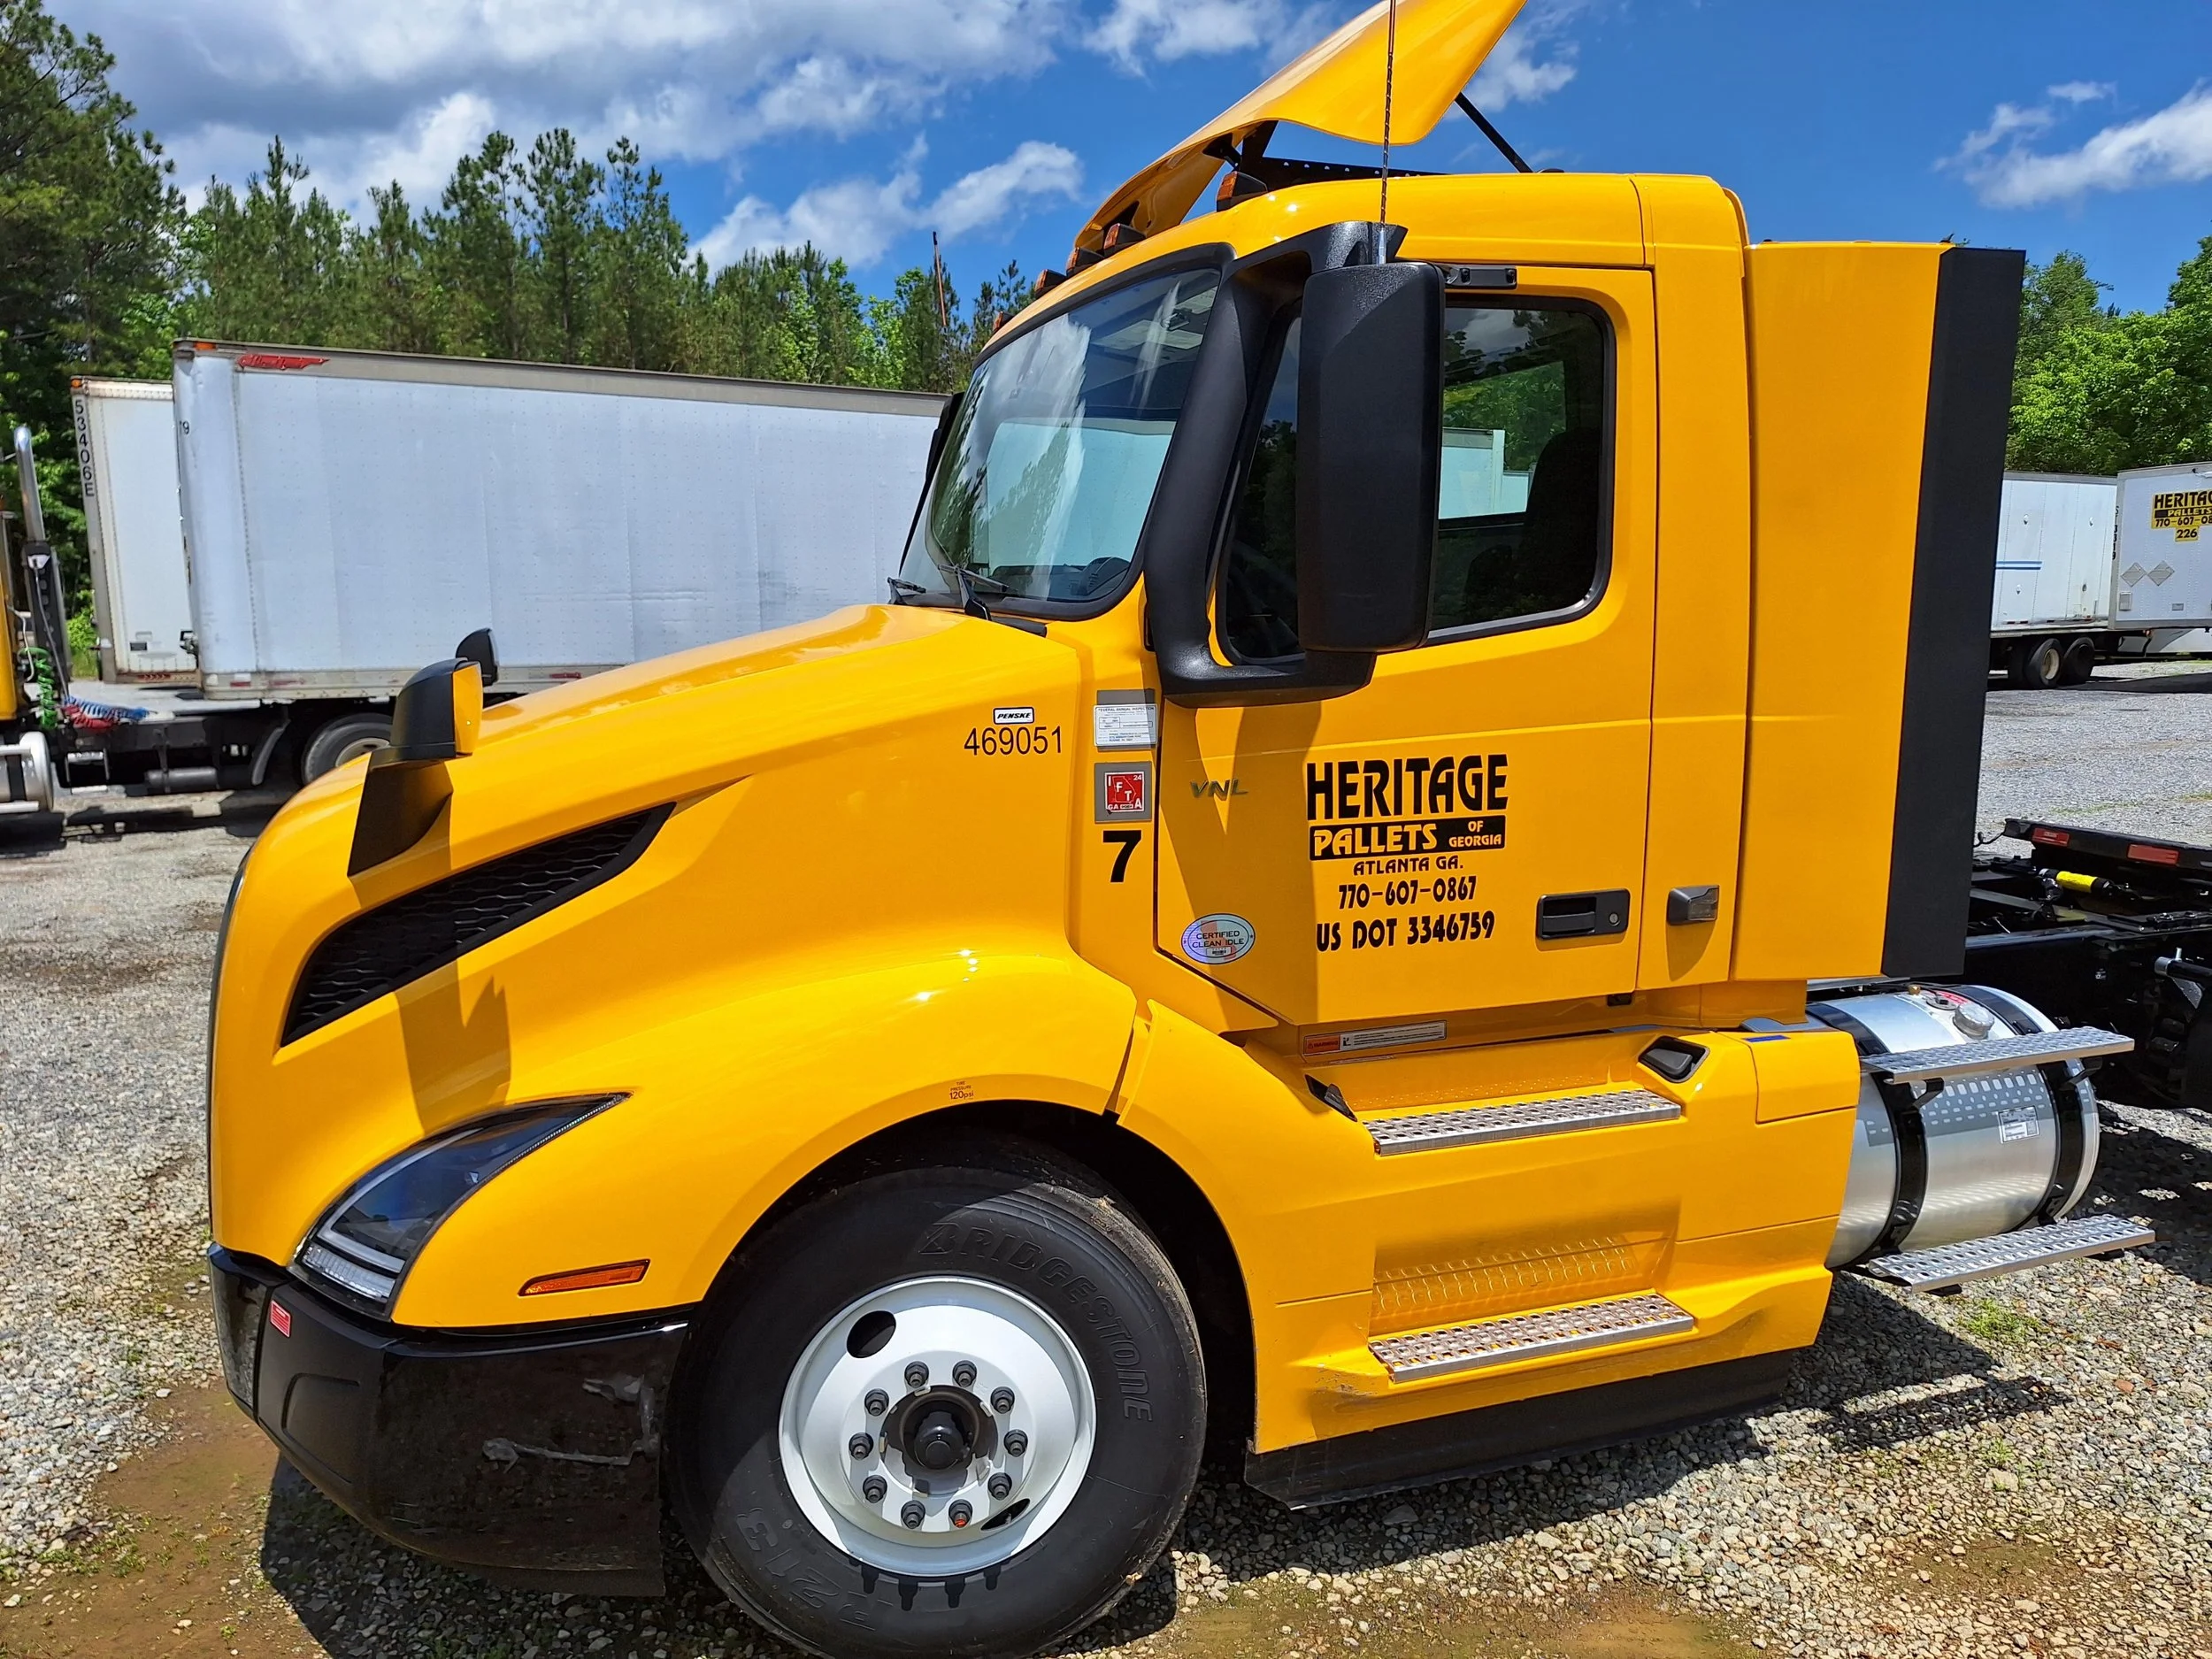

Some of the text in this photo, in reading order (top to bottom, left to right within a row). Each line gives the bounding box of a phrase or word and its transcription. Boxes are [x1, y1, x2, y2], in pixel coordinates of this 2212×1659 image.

[74, 399, 95, 496] 53406E
[2168, 507, 2212, 517] PALLETS
[2176, 528, 2198, 539] 226
[964, 726, 1062, 756] 469051
[1190, 779, 1248, 799] VNL
[1306, 754, 1509, 820] HERITAGE
[1467, 820, 1484, 833] OF
[1313, 823, 1438, 856] PALLETS
[1448, 833, 1502, 849] GEORGIA
[1102, 830, 1142, 883] 7
[1353, 855, 1464, 876] ATLANTA GA.
[1338, 875, 1477, 910] 770-607-0867
[1195, 930, 1240, 940] CERTIFIED
[1316, 910, 1495, 952] US DOT 3346759
[949, 1090, 974, 1100] 120psi
[918, 1222, 1154, 1422] BRIDGESTONE
